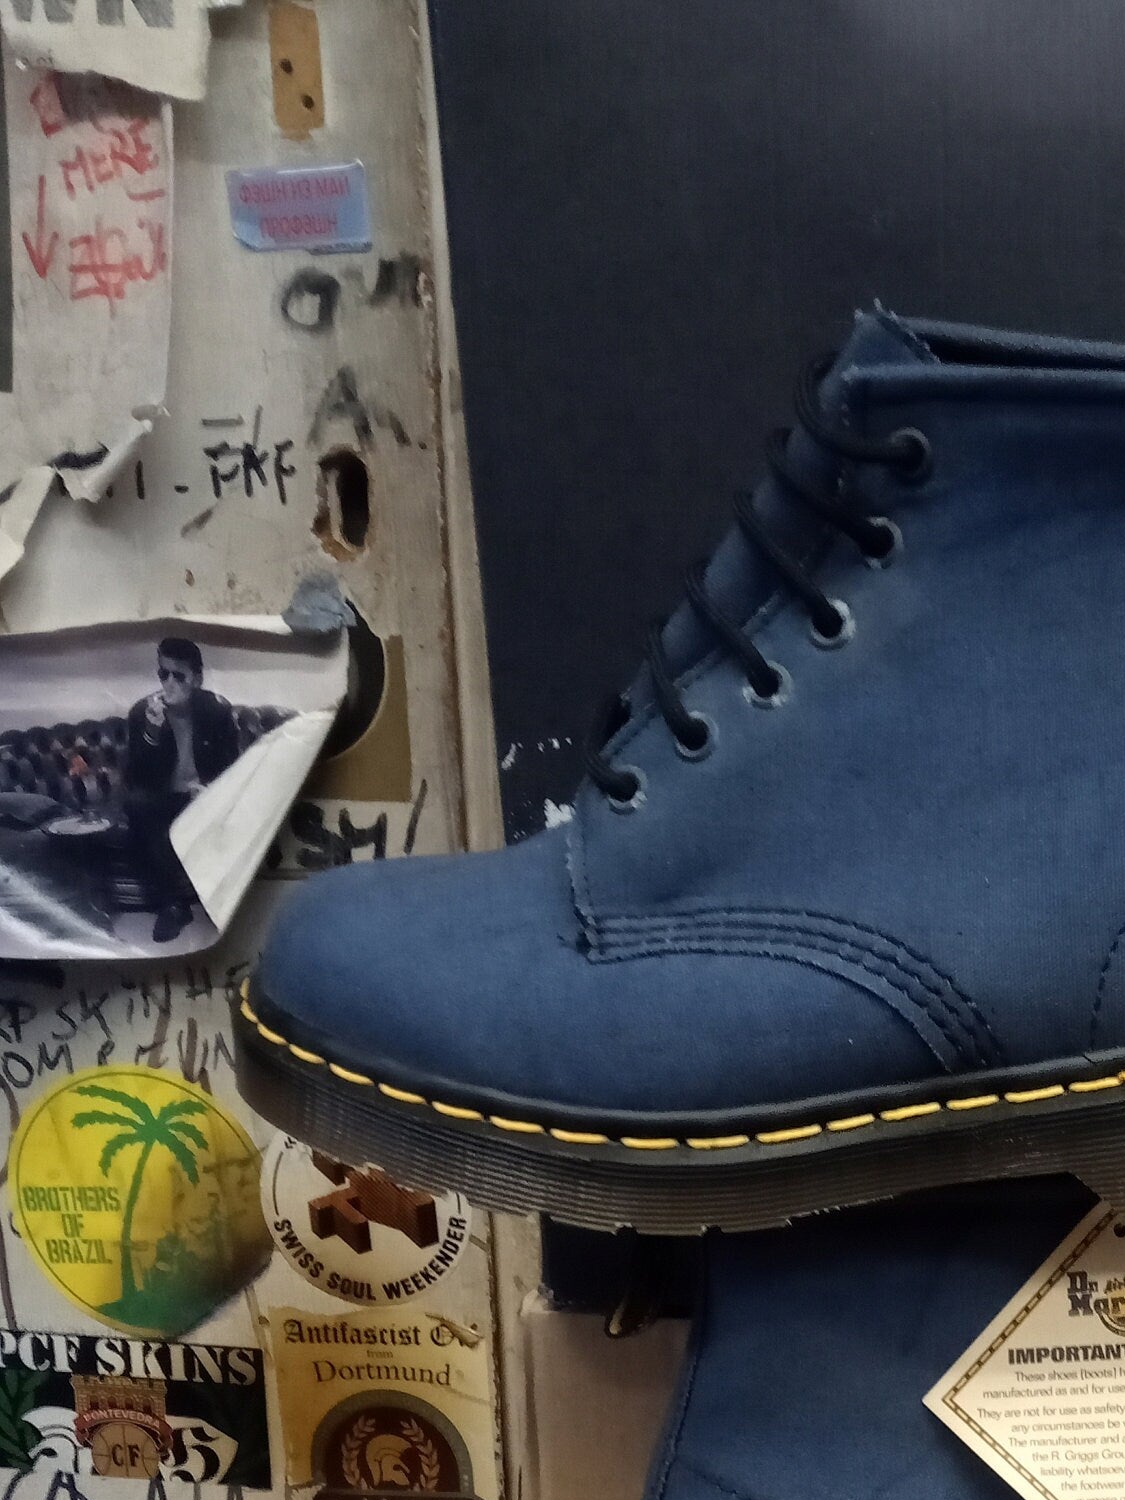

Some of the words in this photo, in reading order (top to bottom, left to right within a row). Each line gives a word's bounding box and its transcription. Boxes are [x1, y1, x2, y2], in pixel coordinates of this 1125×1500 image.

[23, 1186, 120, 1212] BROTHERS
[62, 1213, 83, 1238] OF
[45, 1239, 112, 1264] BRAZIL
[274, 1219, 324, 1277] SWISS
[327, 1272, 376, 1300] SOUL
[382, 1217, 467, 1300] WEEKENDER
[283, 1318, 421, 1346] Antifascist
[95, 1338, 257, 1386] SKINS
[312, 1360, 450, 1386] Dortmund
[1014, 1370, 1045, 1382] These
[1048, 1369, 1077, 1380] shoes
[983, 1386, 1052, 1398] manufactured
[1056, 1387, 1066, 1396] as
[1070, 1384, 1088, 1394] and
[1092, 1383, 1103, 1394] for
[1108, 1384, 1125, 1393] use
[83, 1408, 160, 1428] PONTEVEDRA
[977, 1407, 1000, 1421] They
[1004, 1409, 1020, 1418] are
[1024, 1407, 1039, 1417] not
[1042, 1405, 1055, 1416] for
[1059, 1406, 1077, 1416] use
[1080, 1406, 1091, 1415] as
[1094, 1402, 1125, 1415] safety
